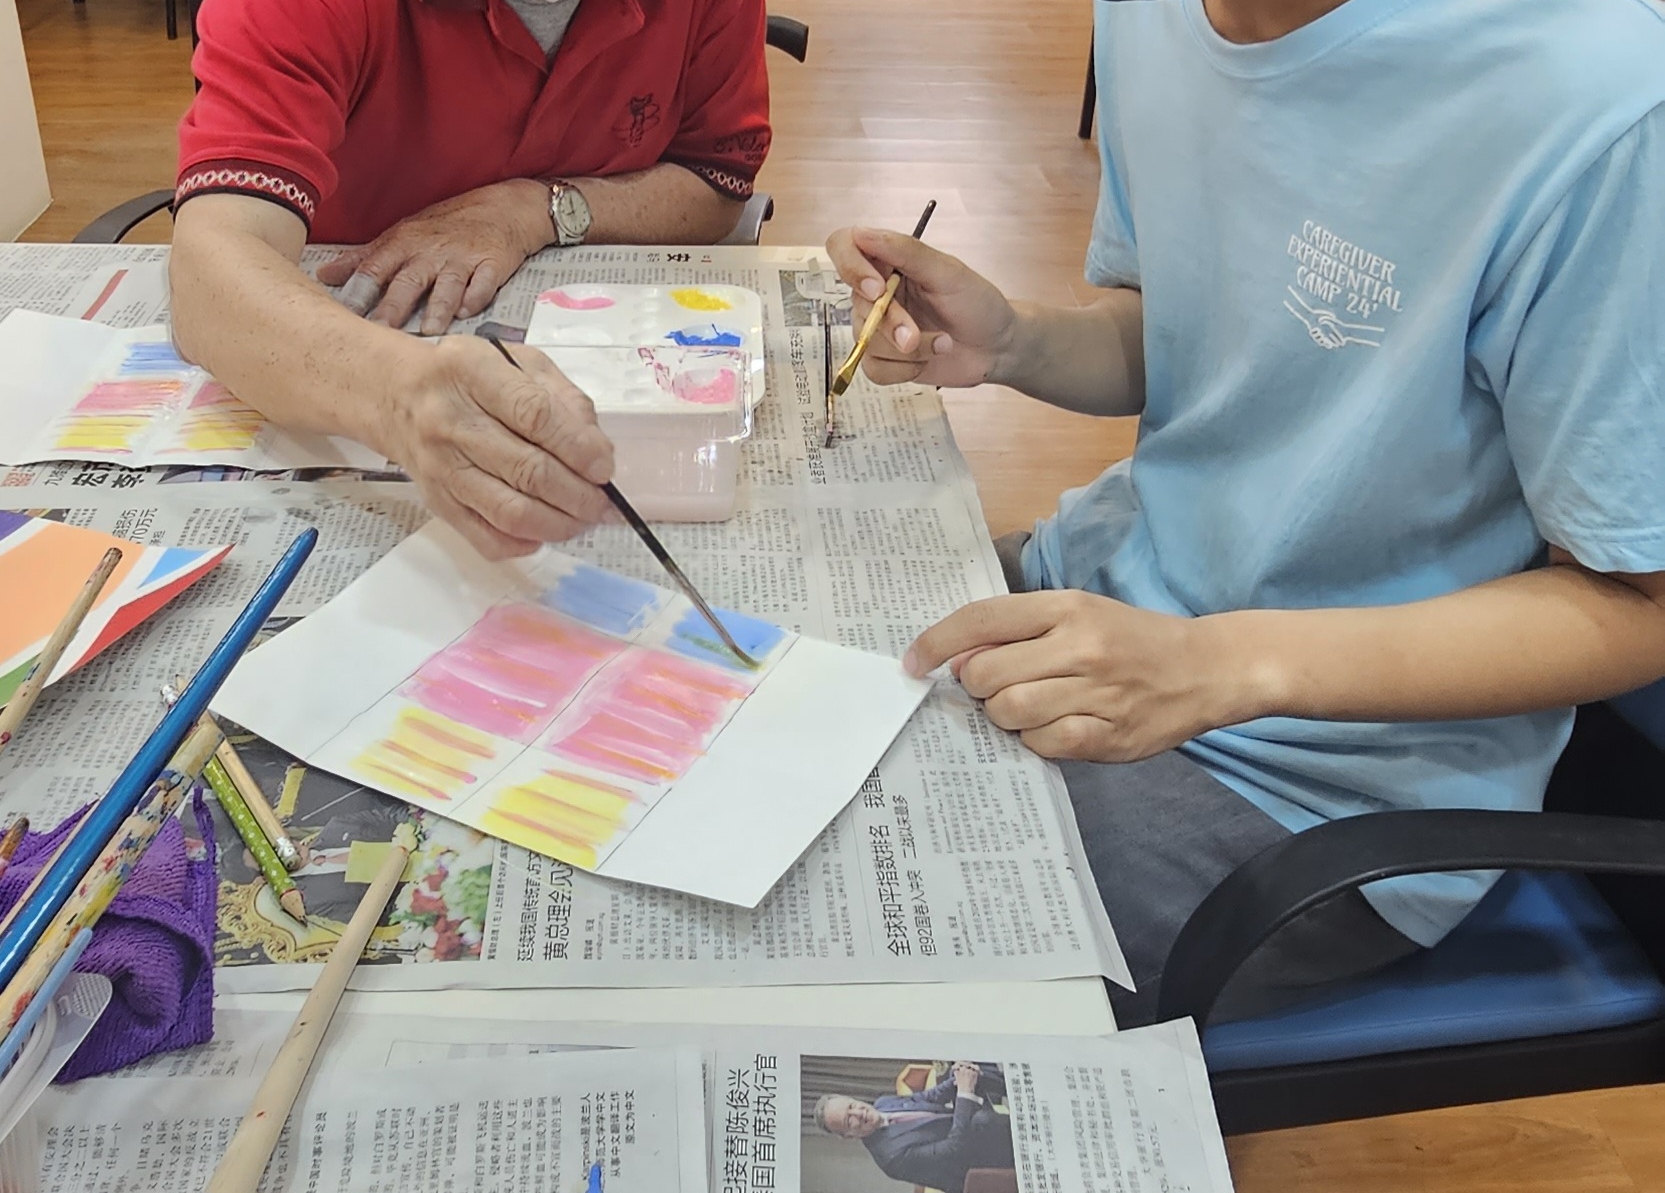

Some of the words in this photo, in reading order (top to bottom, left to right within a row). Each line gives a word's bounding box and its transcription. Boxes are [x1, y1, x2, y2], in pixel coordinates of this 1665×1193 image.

[1287, 234, 1403, 312] EXPERIENTIAL
[1296, 265, 1342, 304] CAMP
[1302, 219, 1396, 284] CAREGIVER
[129, 508, 157, 544] 70万元
[869, 825, 911, 956] 全球和平指数排名
[907, 870, 938, 956] 但92国卷入冲突
[752, 1054, 777, 1193] 国首席执行官
